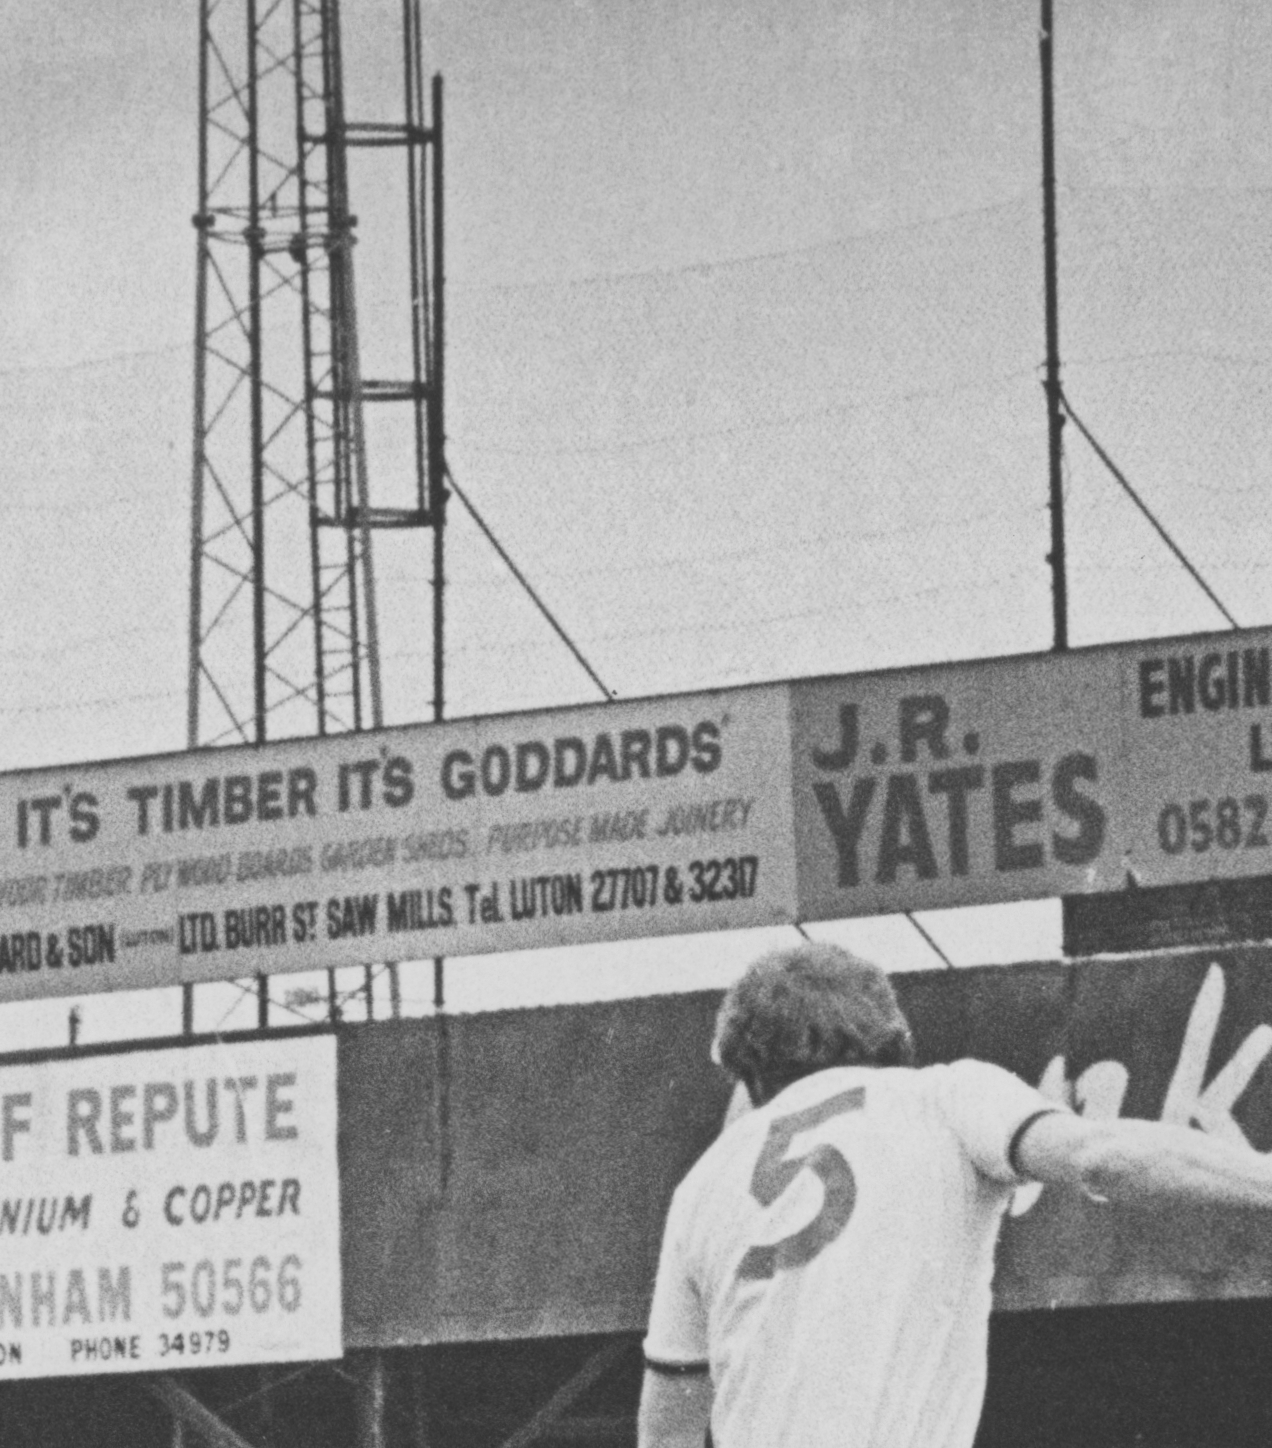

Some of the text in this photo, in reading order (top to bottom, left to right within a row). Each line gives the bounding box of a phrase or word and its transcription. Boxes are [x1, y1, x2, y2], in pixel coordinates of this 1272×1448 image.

[811, 695, 980, 771] J.R.
[16, 784, 100, 849] IT'S
[126, 767, 317, 836] TIMBER
[337, 748, 415, 813] IT'S
[811, 753, 1105, 888] YATES
[45, 933, 65, 969] &
[66, 922, 116, 969] SON
[224, 903, 287, 951] BURR
[327, 893, 379, 941] SAW
[509, 872, 584, 922] LUTON
[590, 864, 660, 914] 27707
[663, 866, 685, 906] &
[66, 1072, 299, 1157] REPUTE
[162, 1178, 302, 1228] COPPER
[734, 1085, 866, 1280] 5
[160, 1254, 304, 1320] 50566
[69, 1334, 142, 1362] PHONE
[158, 1328, 231, 1358] 34979
